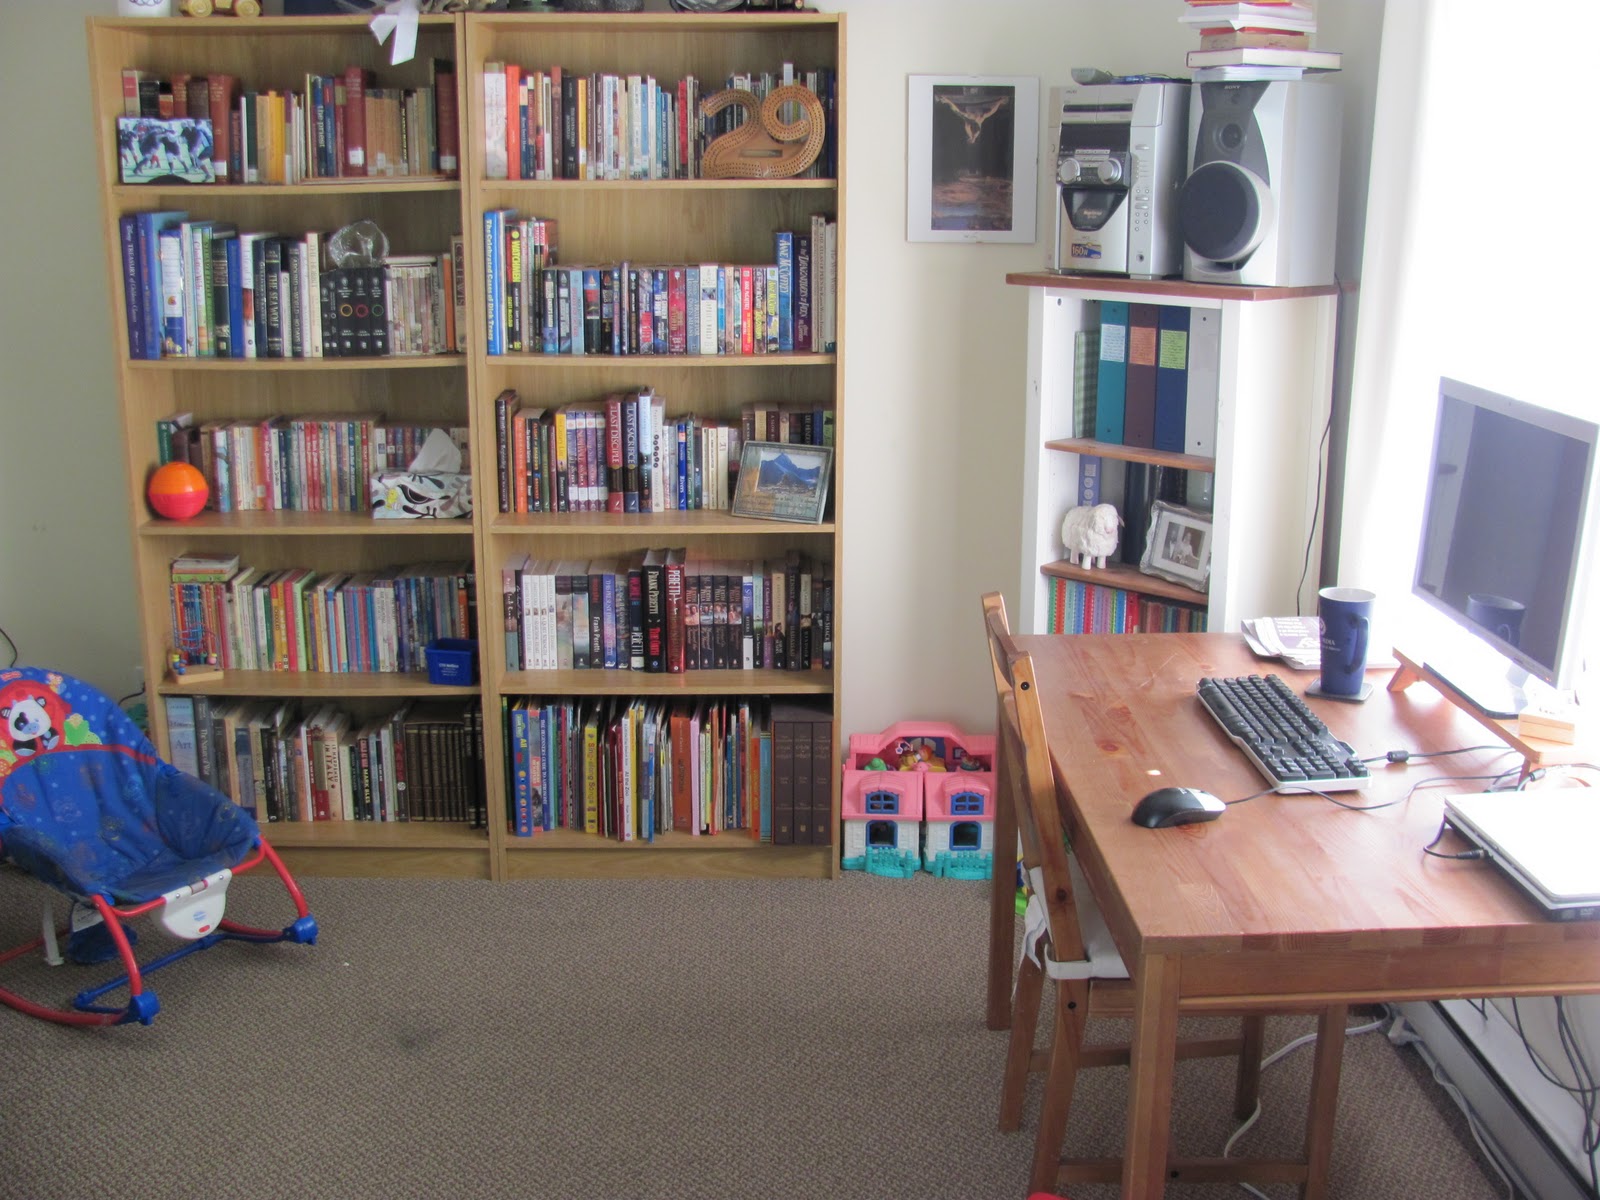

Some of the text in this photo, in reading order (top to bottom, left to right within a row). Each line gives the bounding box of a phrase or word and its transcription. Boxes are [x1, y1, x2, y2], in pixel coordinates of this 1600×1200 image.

[316, 121, 325, 148] priest
[702, 85, 826, 178] 29
[128, 244, 136, 276] TREASURY
[512, 240, 520, 282] WATCHMEN
[268, 274, 280, 328] THE SEA WOLF
[456, 268, 466, 306] LEWIS
[610, 410, 619, 463] LAST DISCIPLE
[627, 408, 636, 463] LAST SACRIFICE
[648, 571, 659, 614] FRANK PERETTI
[668, 570, 680, 596] PERETTI
[632, 632, 642, 654] PERETTI
[650, 628, 660, 640] THE
[176, 740, 192, 749] Art
[325, 744, 334, 782] IN ITALY
[588, 782, 596, 804] Songs
